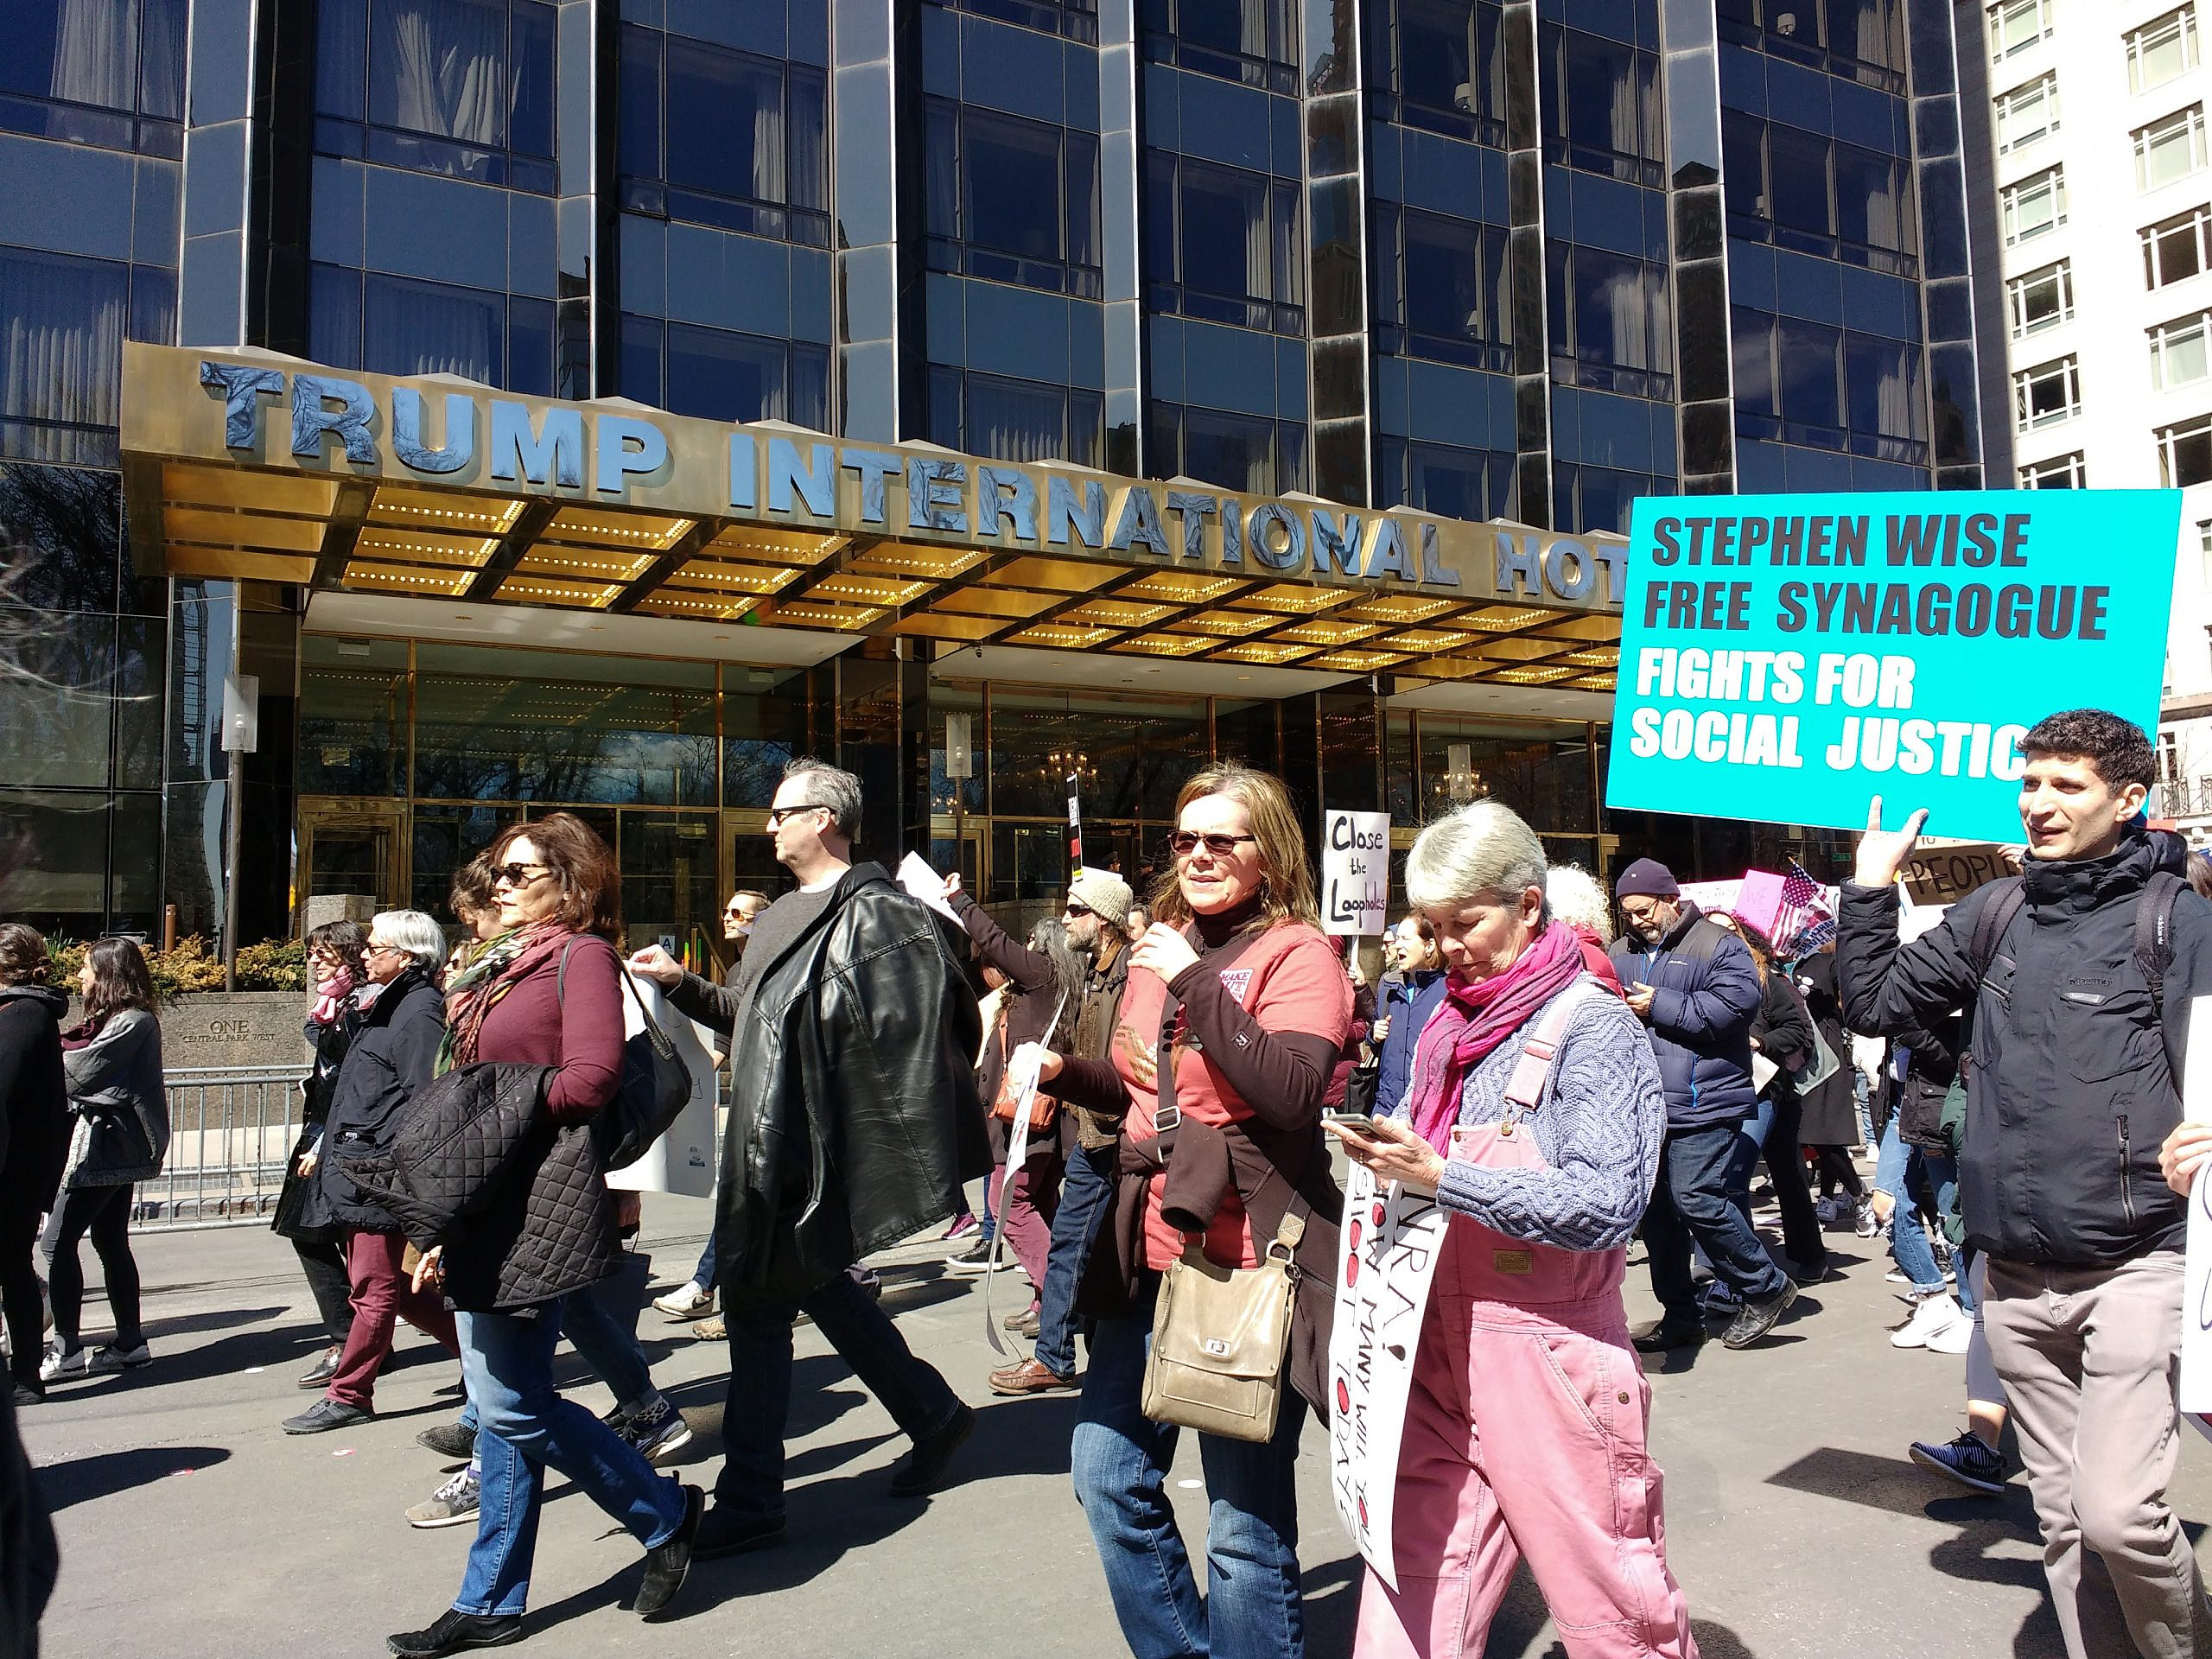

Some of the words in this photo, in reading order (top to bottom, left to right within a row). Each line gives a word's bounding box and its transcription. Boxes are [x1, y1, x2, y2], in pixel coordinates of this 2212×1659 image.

[200, 361, 667, 493] TRUMP
[730, 433, 1459, 585] INTERNATIONAL
[1652, 515, 1871, 567] STEPHEN
[1886, 513, 2031, 568] WISE
[1643, 580, 1753, 631] FREE
[1777, 581, 2110, 641] SYNAGOGUE
[1636, 647, 1806, 704] FIGHTS
[1815, 652, 1916, 709] FOR
[1630, 707, 1803, 768] SOCIAL
[1332, 816, 1383, 851] Close
[1349, 857, 1367, 875] the
[1331, 878, 1385, 929] Loopholes
[663, 938, 673, 950] A
[209, 1020, 250, 1034] ONE
[226, 1033, 249, 1042] PARK
[1356, 1296, 1378, 1394] MANY
[1355, 1478, 1374, 1555] YOU
